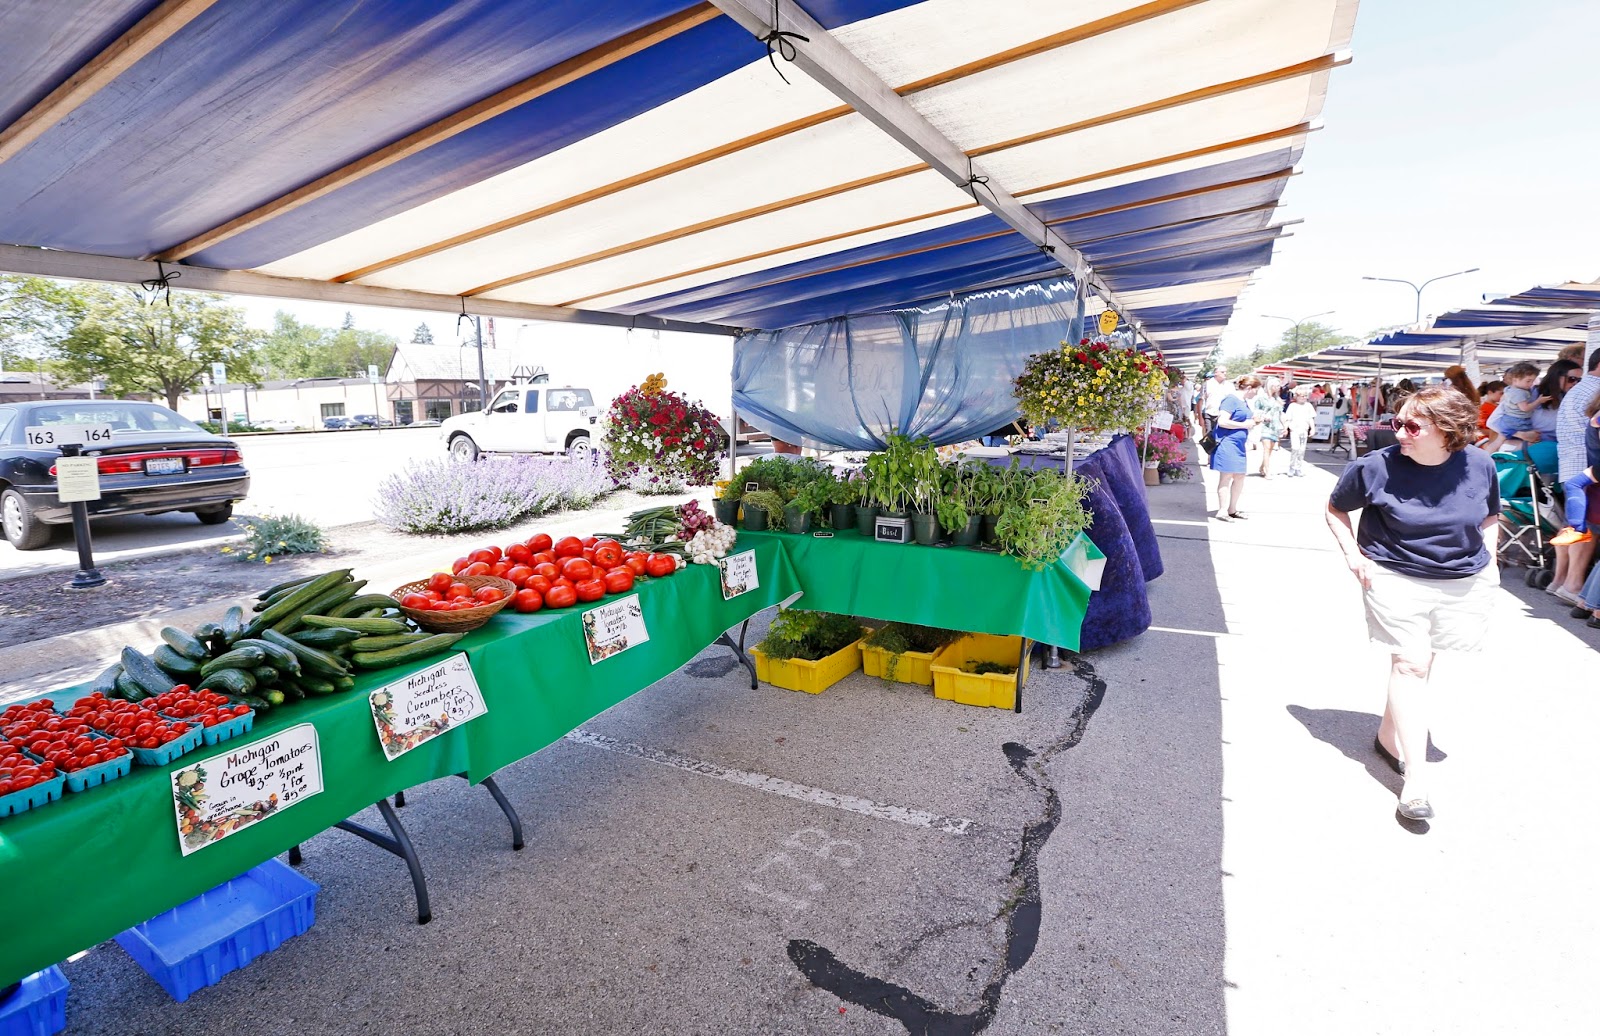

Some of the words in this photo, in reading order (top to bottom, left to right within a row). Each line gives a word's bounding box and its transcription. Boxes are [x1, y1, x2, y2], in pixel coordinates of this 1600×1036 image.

[27, 431, 55, 445] 163
[85, 428, 111, 442] 164
[408, 666, 447, 689] Michigan
[407, 685, 463, 714] Cucumbers
[413, 682, 448, 699] Seedless
[454, 695, 467, 706] for
[227, 739, 280, 770] Michigan
[220, 766, 258, 788] Grape
[264, 742, 313, 770] Tomatoes
[281, 783, 288, 794] 2
[291, 774, 306, 788] for
[209, 800, 229, 810] Grown
